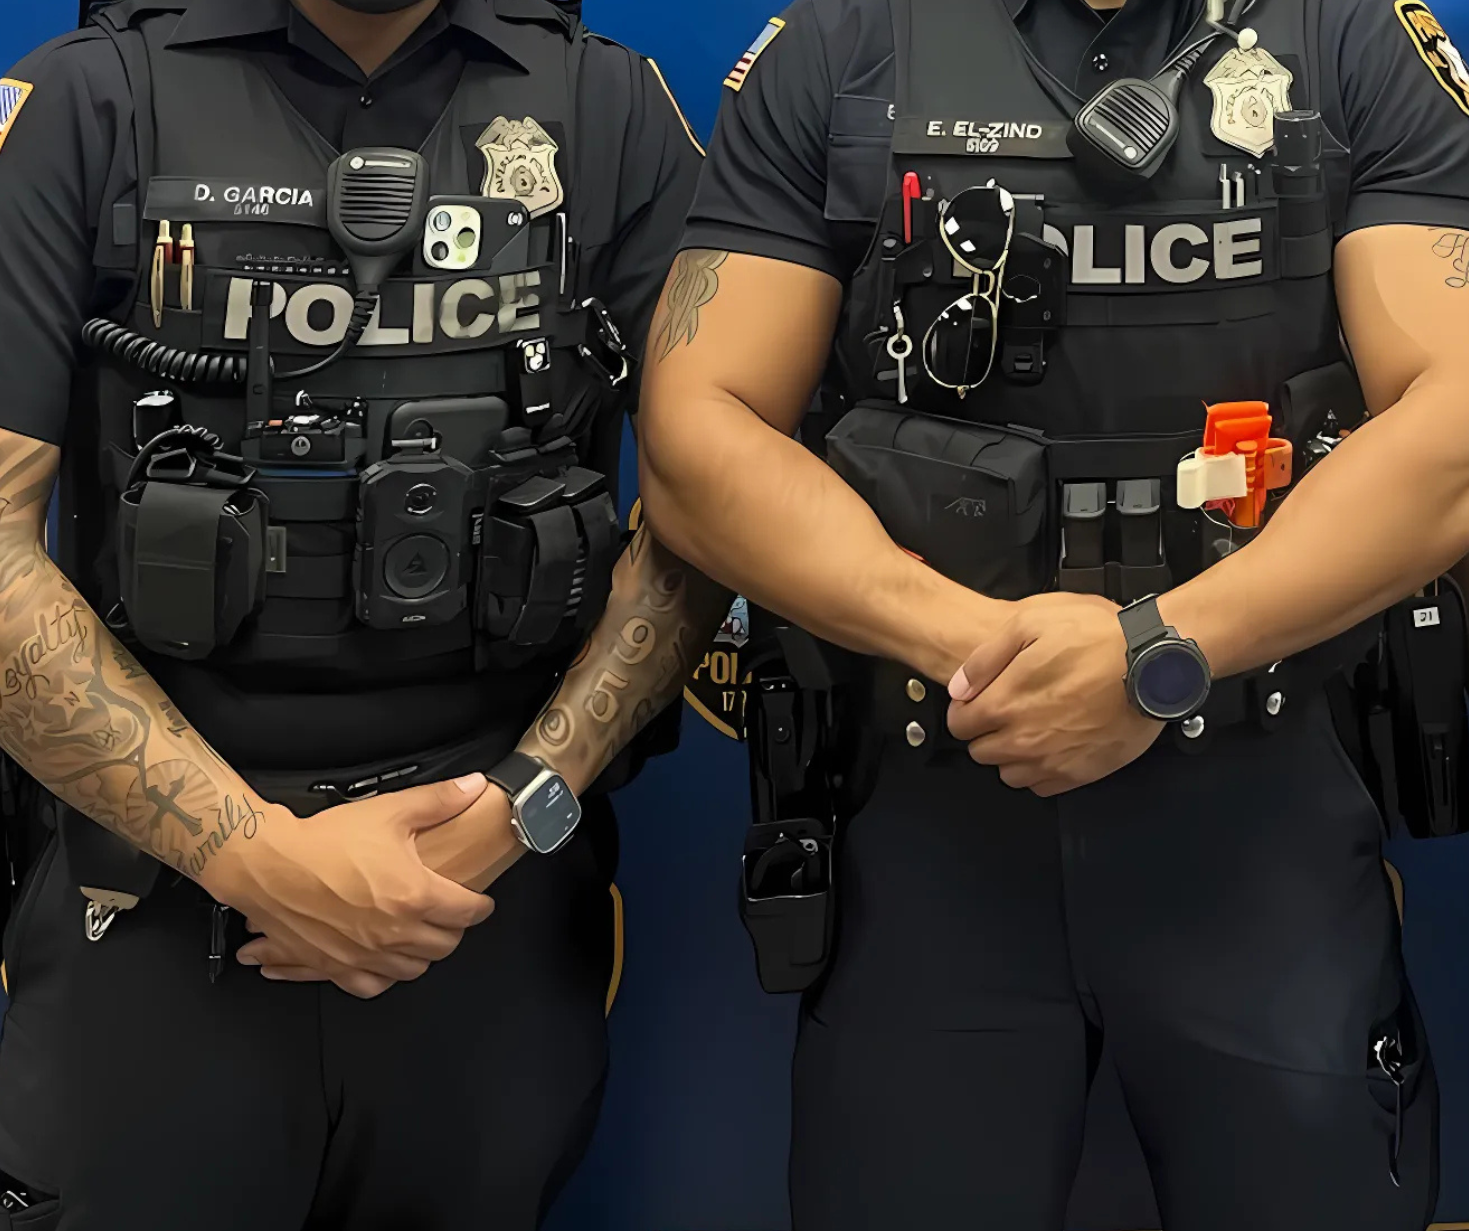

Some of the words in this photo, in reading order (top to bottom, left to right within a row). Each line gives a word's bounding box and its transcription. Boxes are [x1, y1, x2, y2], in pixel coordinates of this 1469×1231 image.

[927, 121, 946, 136] E.
[953, 121, 1042, 139] EL-ZIND
[194, 183, 215, 202] D.
[223, 186, 313, 207] GARCIA
[224, 270, 541, 346] POLICE
